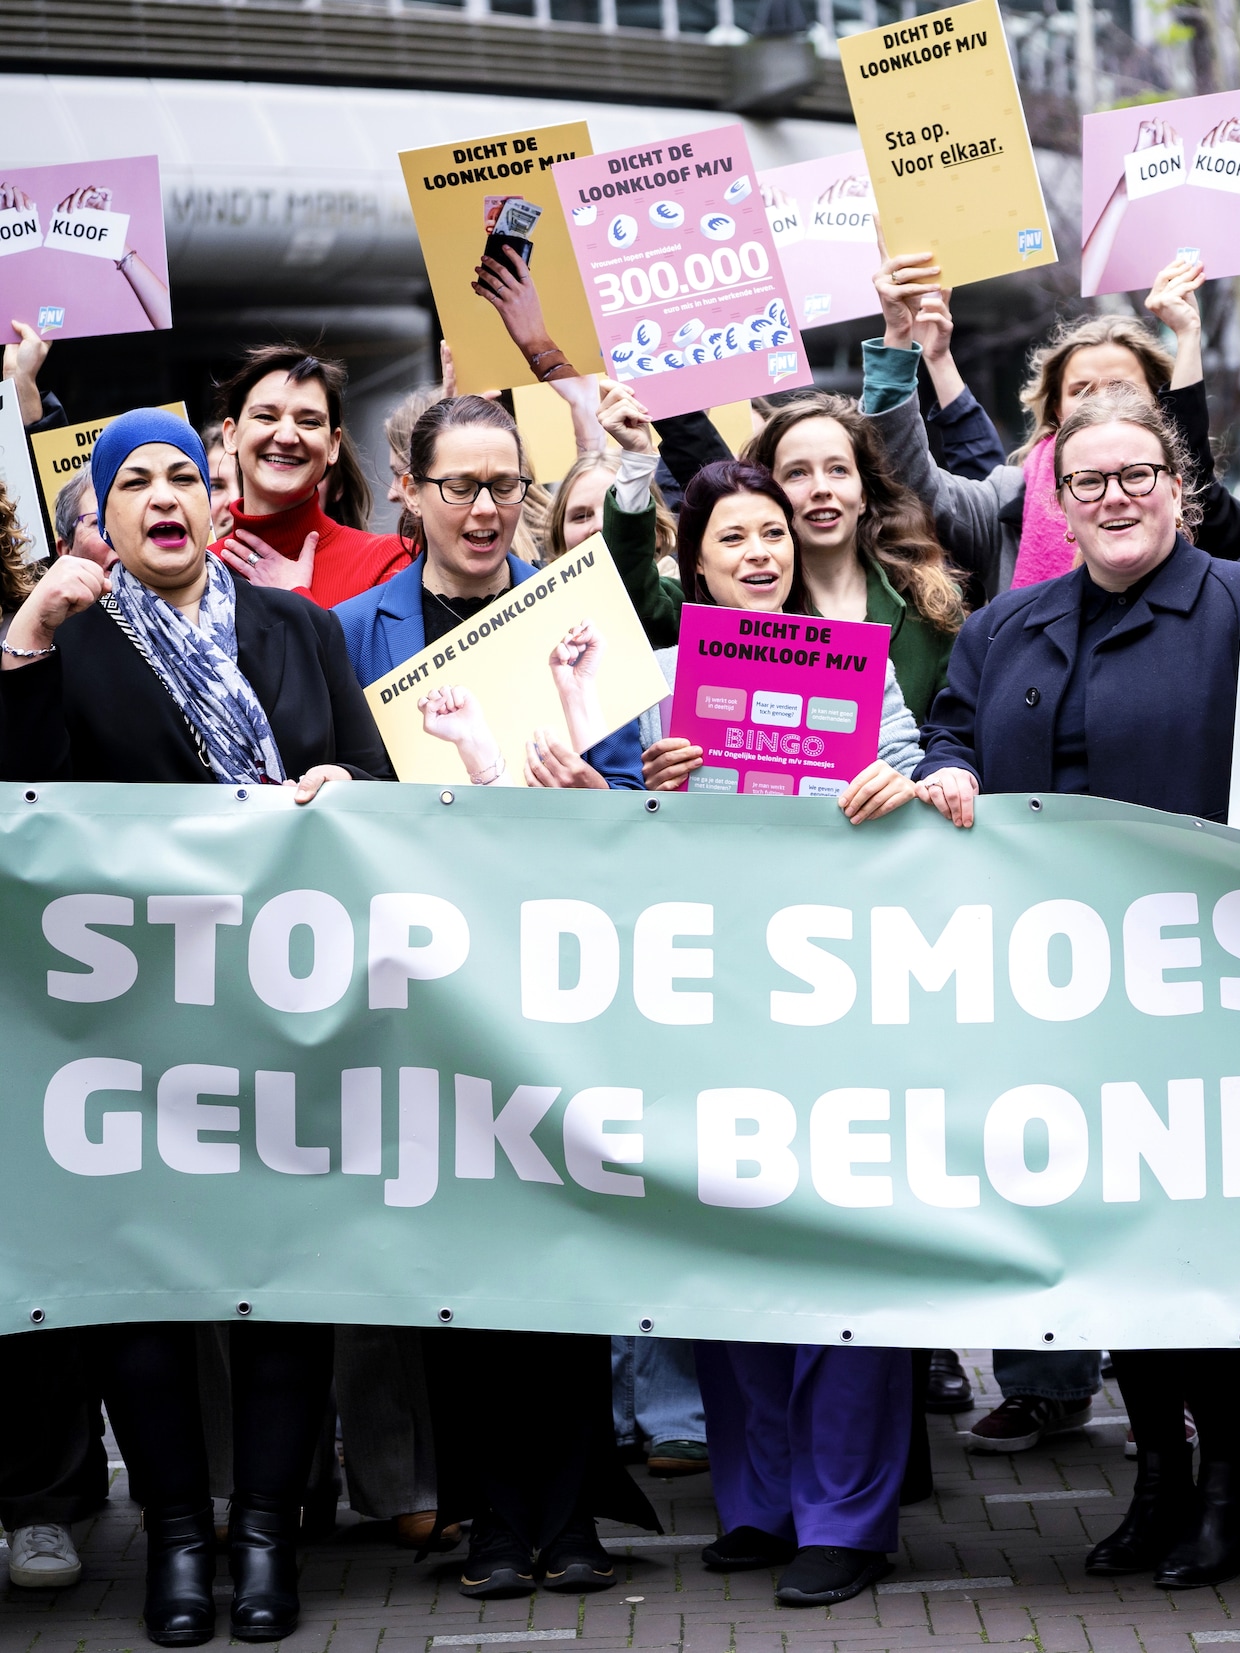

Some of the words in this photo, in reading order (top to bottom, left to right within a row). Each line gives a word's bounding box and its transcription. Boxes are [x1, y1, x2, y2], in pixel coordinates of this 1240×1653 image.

[883, 24, 929, 49] DICHT
[933, 17, 954, 36] DE
[860, 41, 952, 79] LOONKLOOF
[955, 31, 988, 53] M/V
[885, 130, 916, 150] Sta
[921, 123, 950, 142] op.
[453, 142, 508, 164] DICHT
[512, 137, 538, 154] DE
[608, 150, 663, 174] DICHT
[668, 143, 694, 161] DE
[891, 154, 934, 177] Voor
[940, 137, 1003, 167] elkaar.
[423, 160, 534, 191] LOONKLOOF
[578, 167, 691, 203] LOONKLOOF
[696, 157, 733, 179] M/V
[1140, 155, 1181, 181] LOON
[0, 219, 37, 240] OON
[53, 220, 109, 241] KLOOF
[773, 214, 797, 232] ON
[814, 212, 871, 227] KLOOF
[1020, 232, 1042, 248] FNV
[590, 256, 623, 269] Vrouwen
[624, 252, 644, 264] lopen
[645, 244, 682, 258] gemiddeld
[593, 241, 769, 312] 300.000
[663, 306, 680, 314] euro
[681, 303, 693, 312] mis
[694, 301, 701, 309] in
[703, 297, 717, 306] hun
[718, 289, 752, 303] werkende
[754, 284, 775, 296] leven.
[40, 309, 64, 325] FNV
[770, 355, 797, 373] FNV
[75, 428, 104, 446] DIC
[379, 663, 429, 704] DICHT
[432, 646, 456, 670] DE
[457, 577, 558, 651] LOONKLOOF
[560, 551, 596, 583] M/V
[739, 619, 800, 640] DICHT
[805, 626, 832, 643] DE
[698, 639, 820, 667] LOONKLOOF
[826, 653, 867, 672] M/V
[772, 710, 795, 718] genoeg?
[812, 714, 852, 723] onderhandelen
[724, 727, 825, 757] BINGO
[709, 749, 723, 757] FNV
[724, 750, 756, 761] Ongelijke
[757, 754, 787, 765] beloning
[788, 756, 802, 765] m/v
[803, 759, 836, 769] smoesjes
[706, 783, 732, 791] kinderen?
[42, 889, 470, 1013] STOP
[520, 898, 714, 1025] DE
[43, 1057, 645, 1207] GELIJKE
